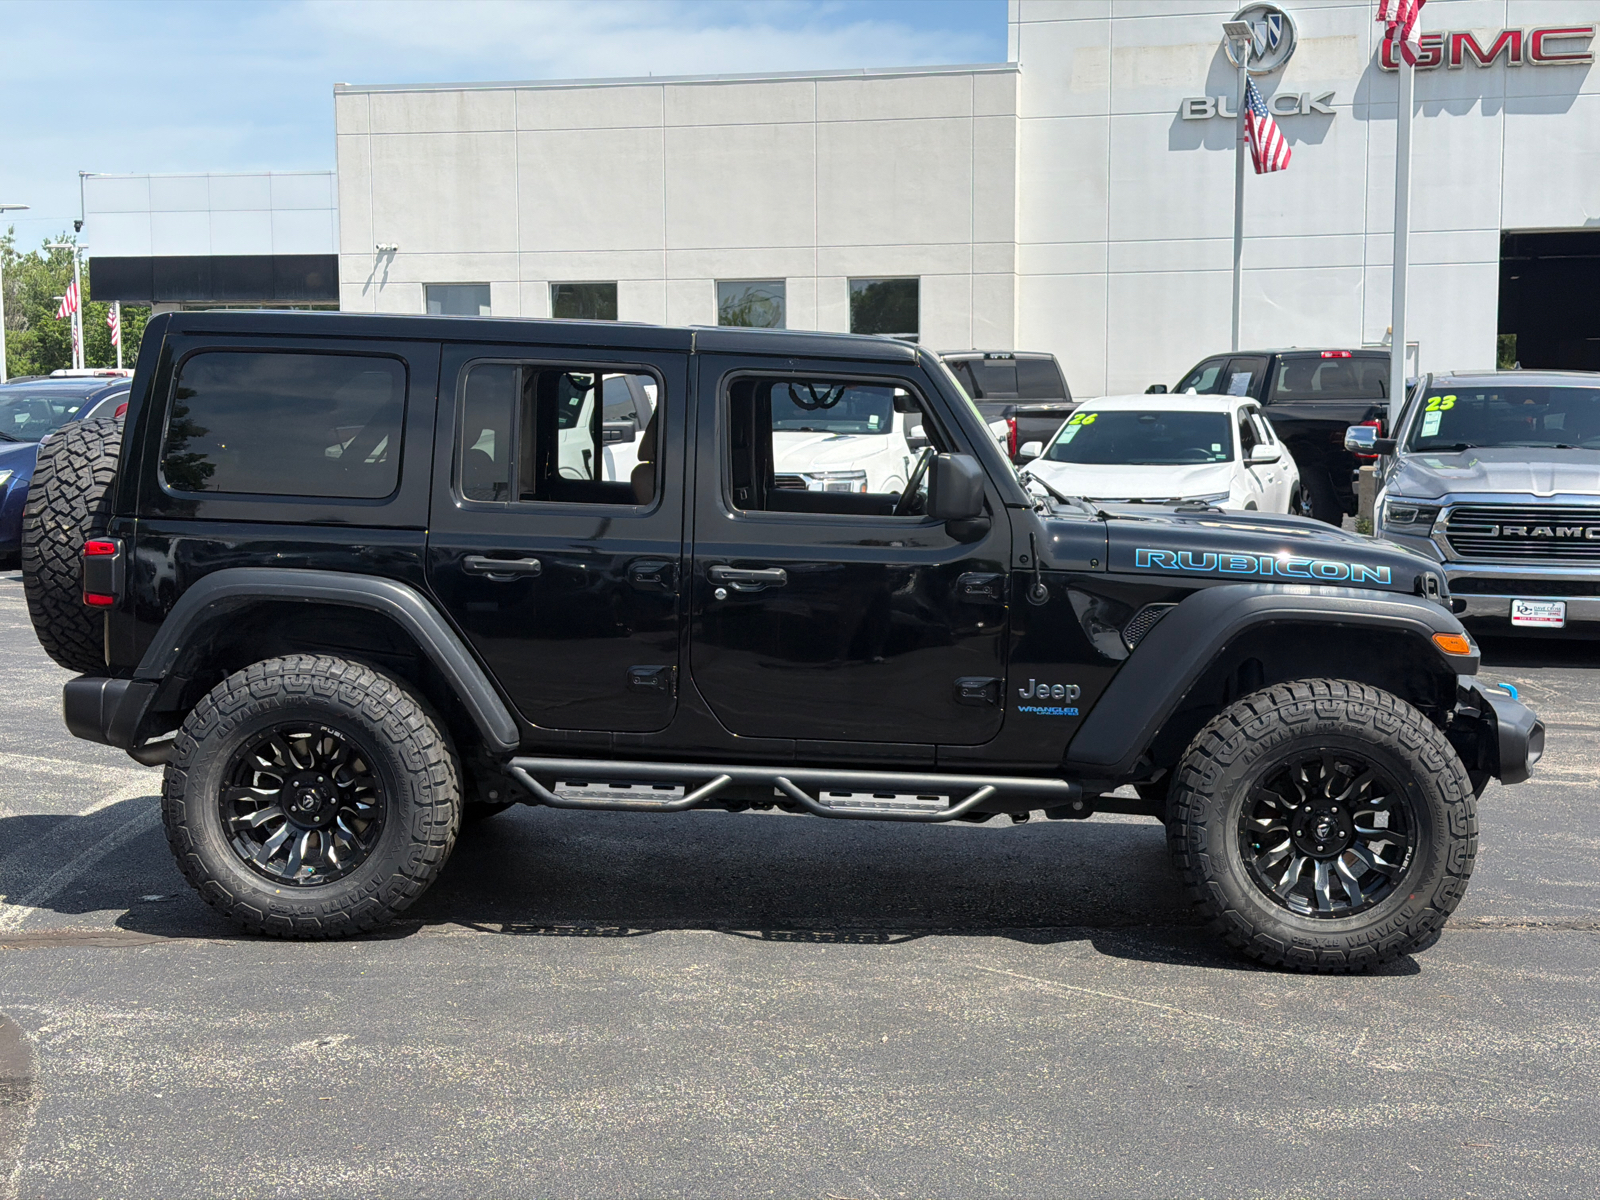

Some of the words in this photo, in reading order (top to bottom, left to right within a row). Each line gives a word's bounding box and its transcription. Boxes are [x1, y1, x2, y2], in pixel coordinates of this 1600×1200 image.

[1378, 24, 1596, 72] GMC
[1182, 91, 1337, 120] BUCK
[1425, 395, 1457, 411] 23
[1069, 413, 1098, 425] 26
[1503, 525, 1582, 537] RAM
[1136, 548, 1391, 584] RUBICON
[1018, 678, 1081, 704] Jeep
[320, 725, 346, 741] FUEL
[1399, 846, 1413, 873] FUEL
